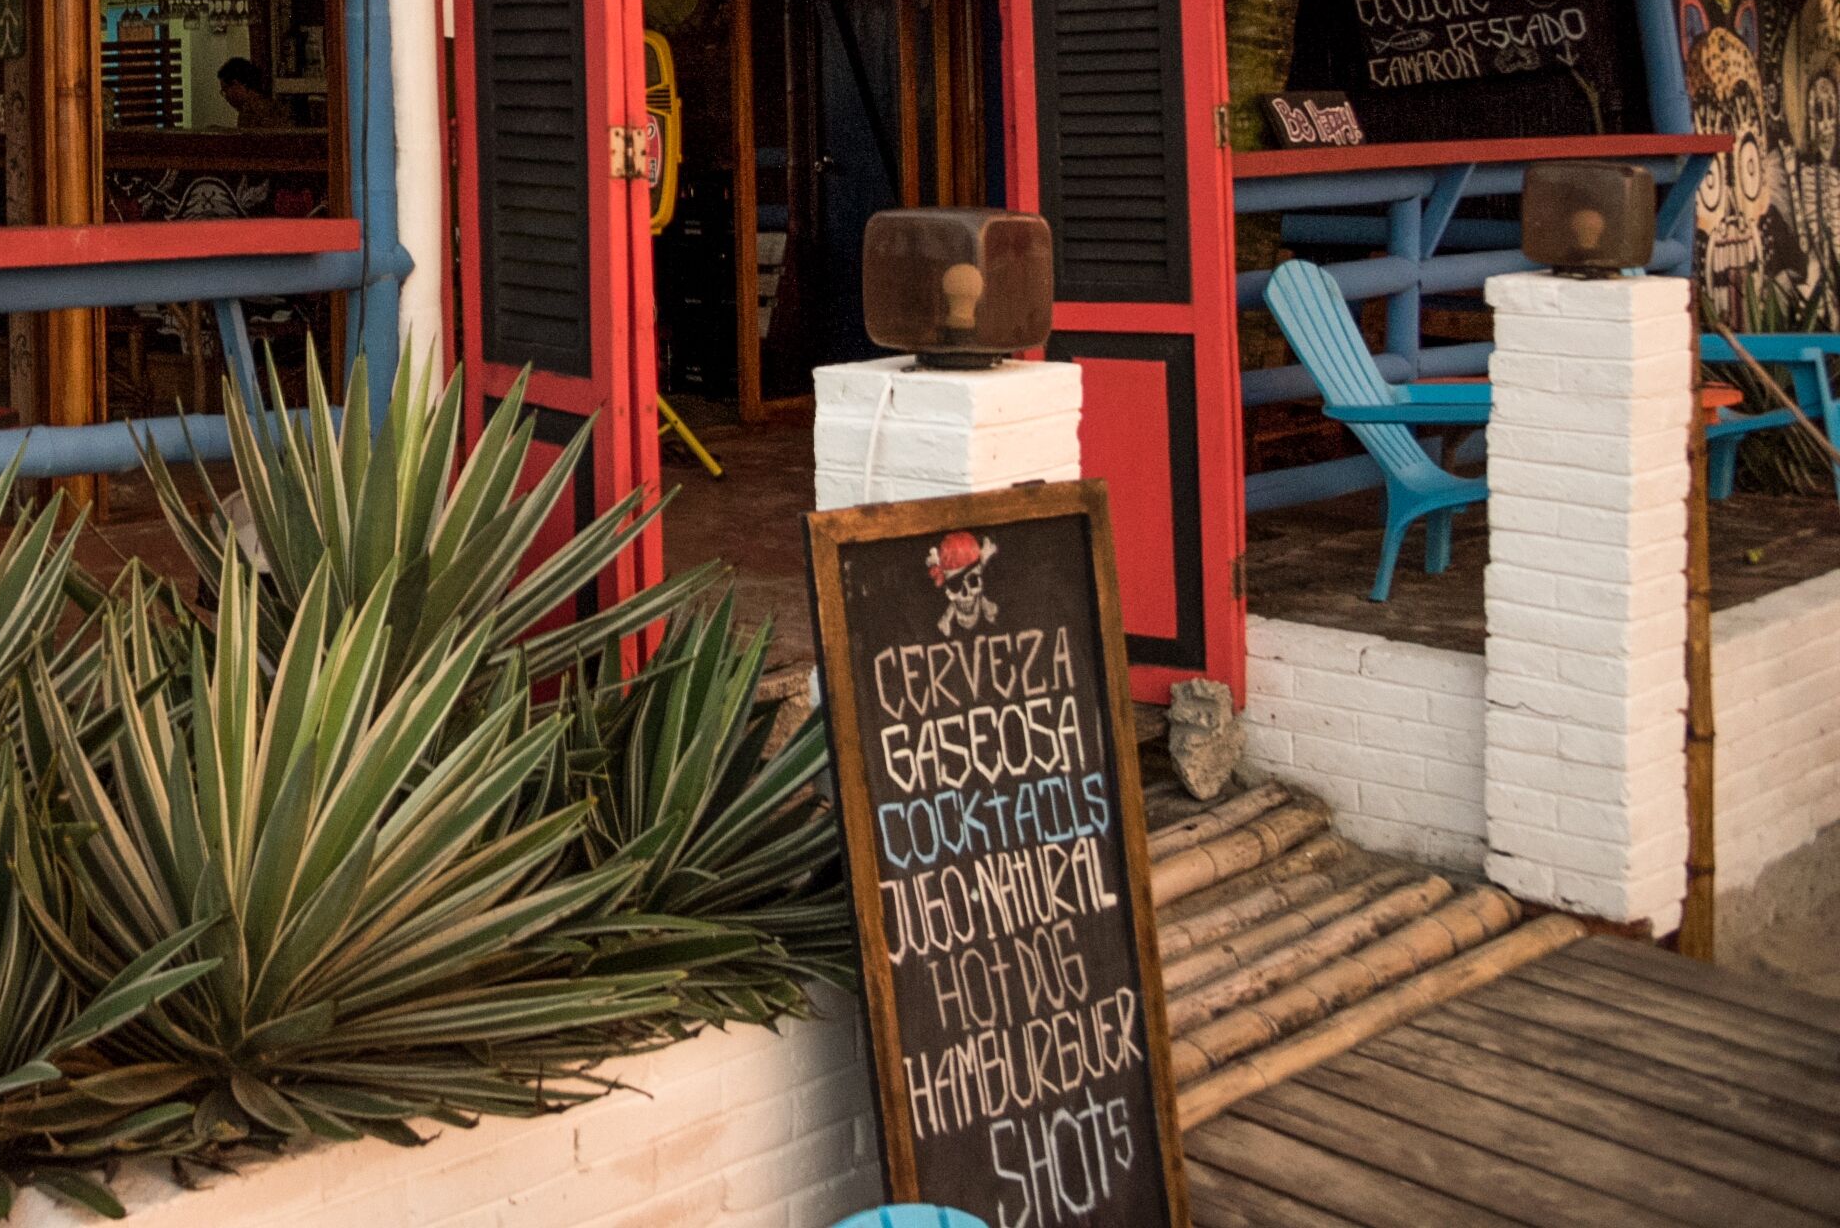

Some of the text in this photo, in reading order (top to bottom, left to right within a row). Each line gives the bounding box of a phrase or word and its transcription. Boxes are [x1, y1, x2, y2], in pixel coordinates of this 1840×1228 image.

[1368, 43, 1481, 87] CAMARON
[1446, 8, 1587, 49] PESCADO
[874, 626, 1076, 720] CERVEZA
[880, 696, 1086, 793] GASEOSA
[878, 773, 1109, 868] COCKTAILS
[928, 919, 1088, 1031] HOT DOG
[903, 987, 1144, 1140] HAMBURGUER
[989, 1087, 1134, 1228] SHOTS
